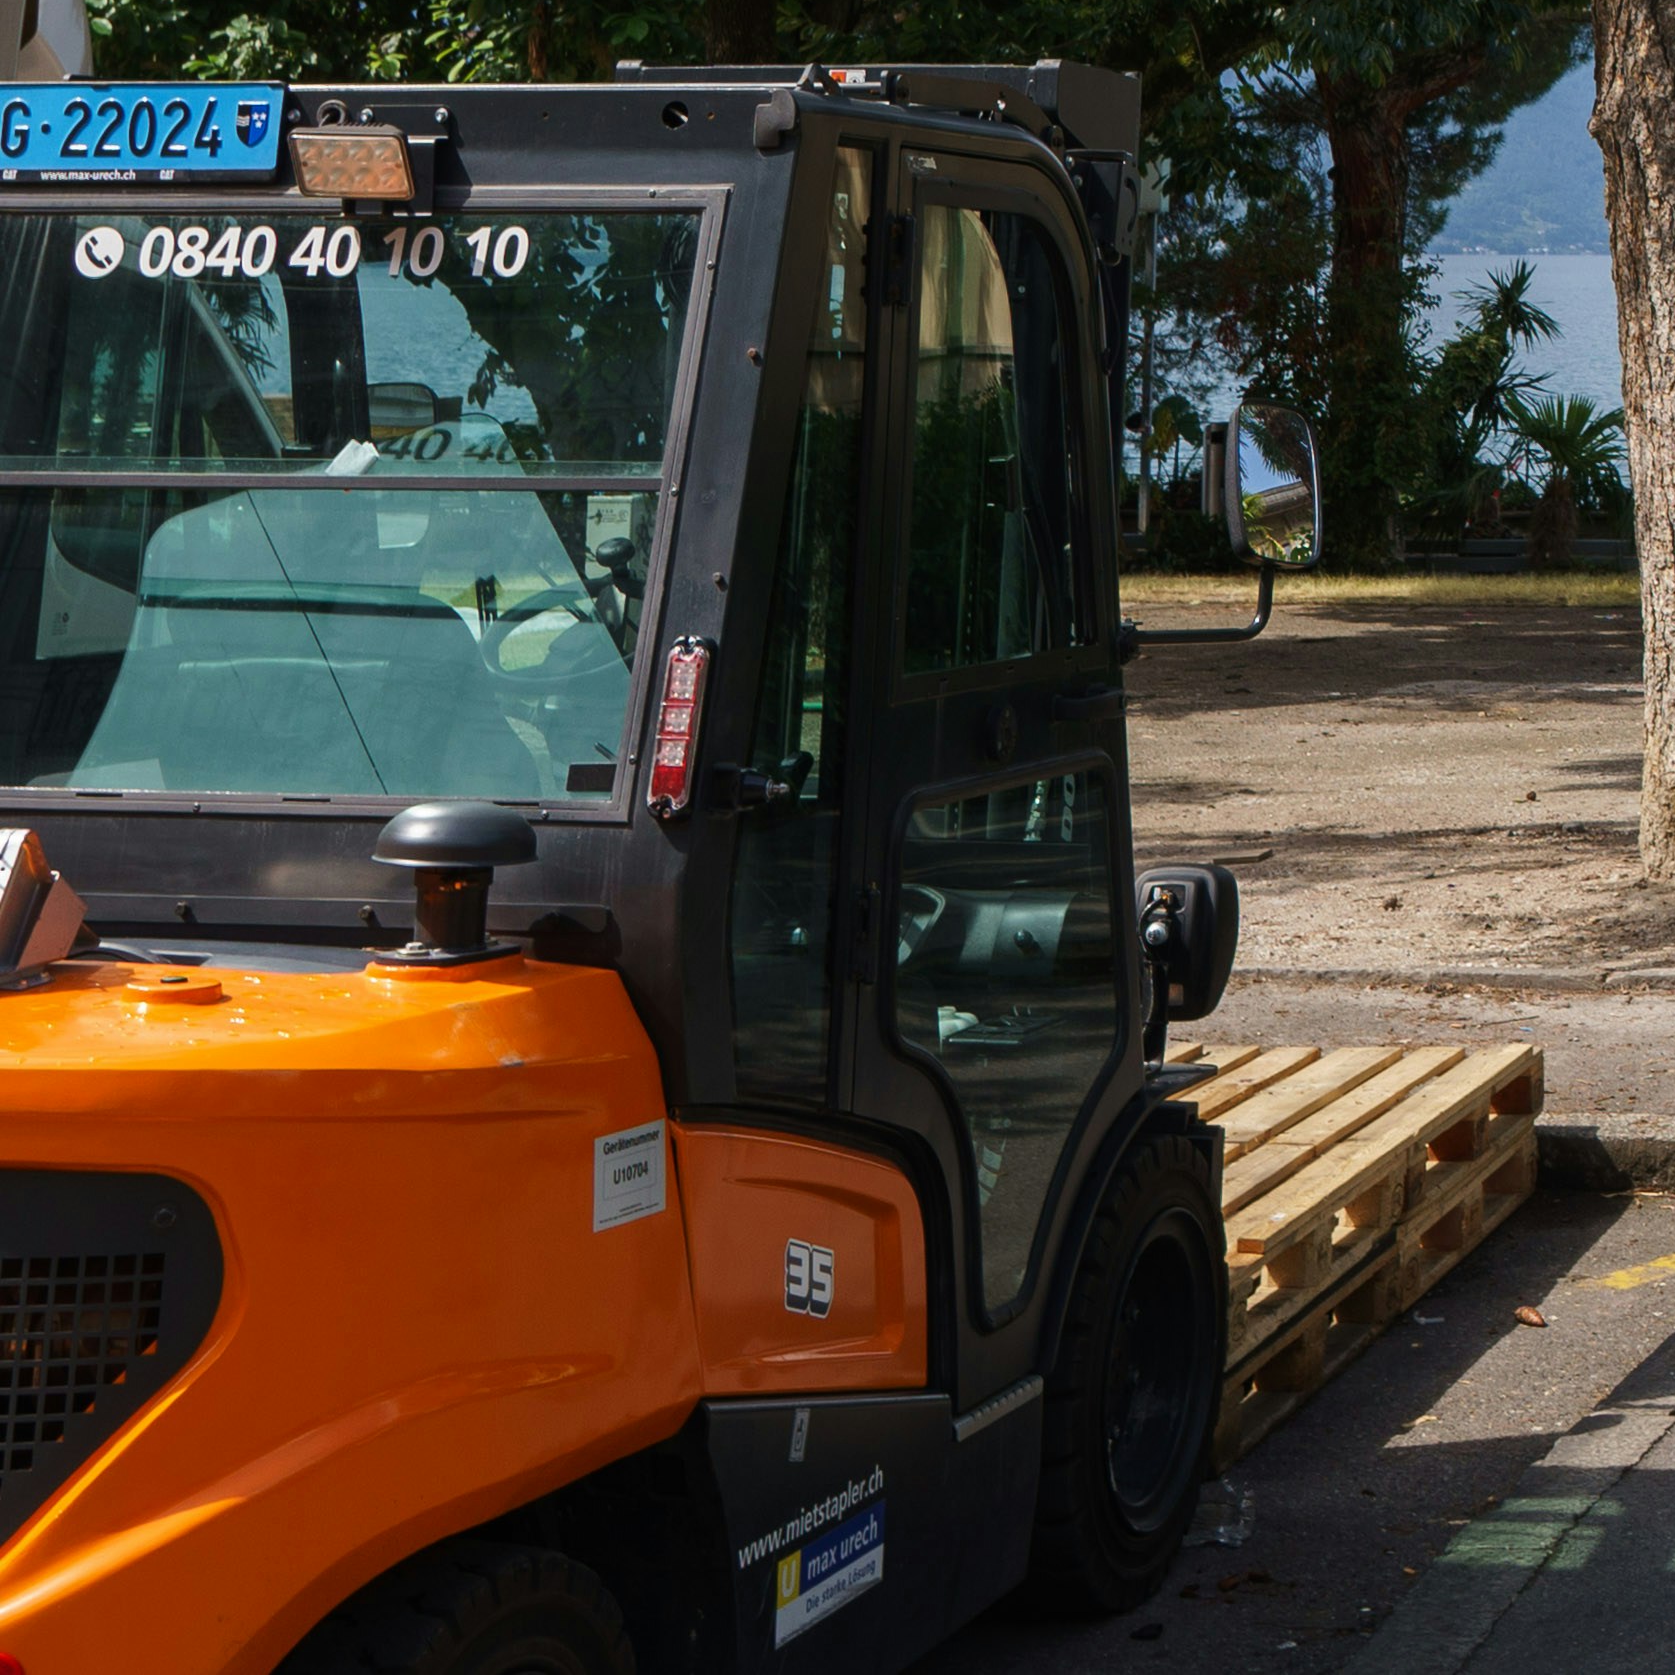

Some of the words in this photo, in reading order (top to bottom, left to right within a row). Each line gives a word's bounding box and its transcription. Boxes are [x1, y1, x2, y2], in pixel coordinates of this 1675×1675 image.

[41, 169, 136, 181] www.max-urech.ch
[138, 225, 277, 278] 0840
[289, 225, 361, 278] 40
[384, 225, 444, 278] 10
[467, 225, 529, 278] 10
[603, 1130, 660, 1155] Gerätenummer
[613, 1161, 649, 1185] U10704
[785, 1238, 834, 1318] 35
[738, 1464, 883, 1568] www.mietstapler.ch
[807, 1546, 837, 1580] max
[840, 1513, 878, 1560] urech
[806, 1596, 820, 1613] Die
[821, 1577, 846, 1603] starke
[848, 1559, 876, 1587] Lösung
